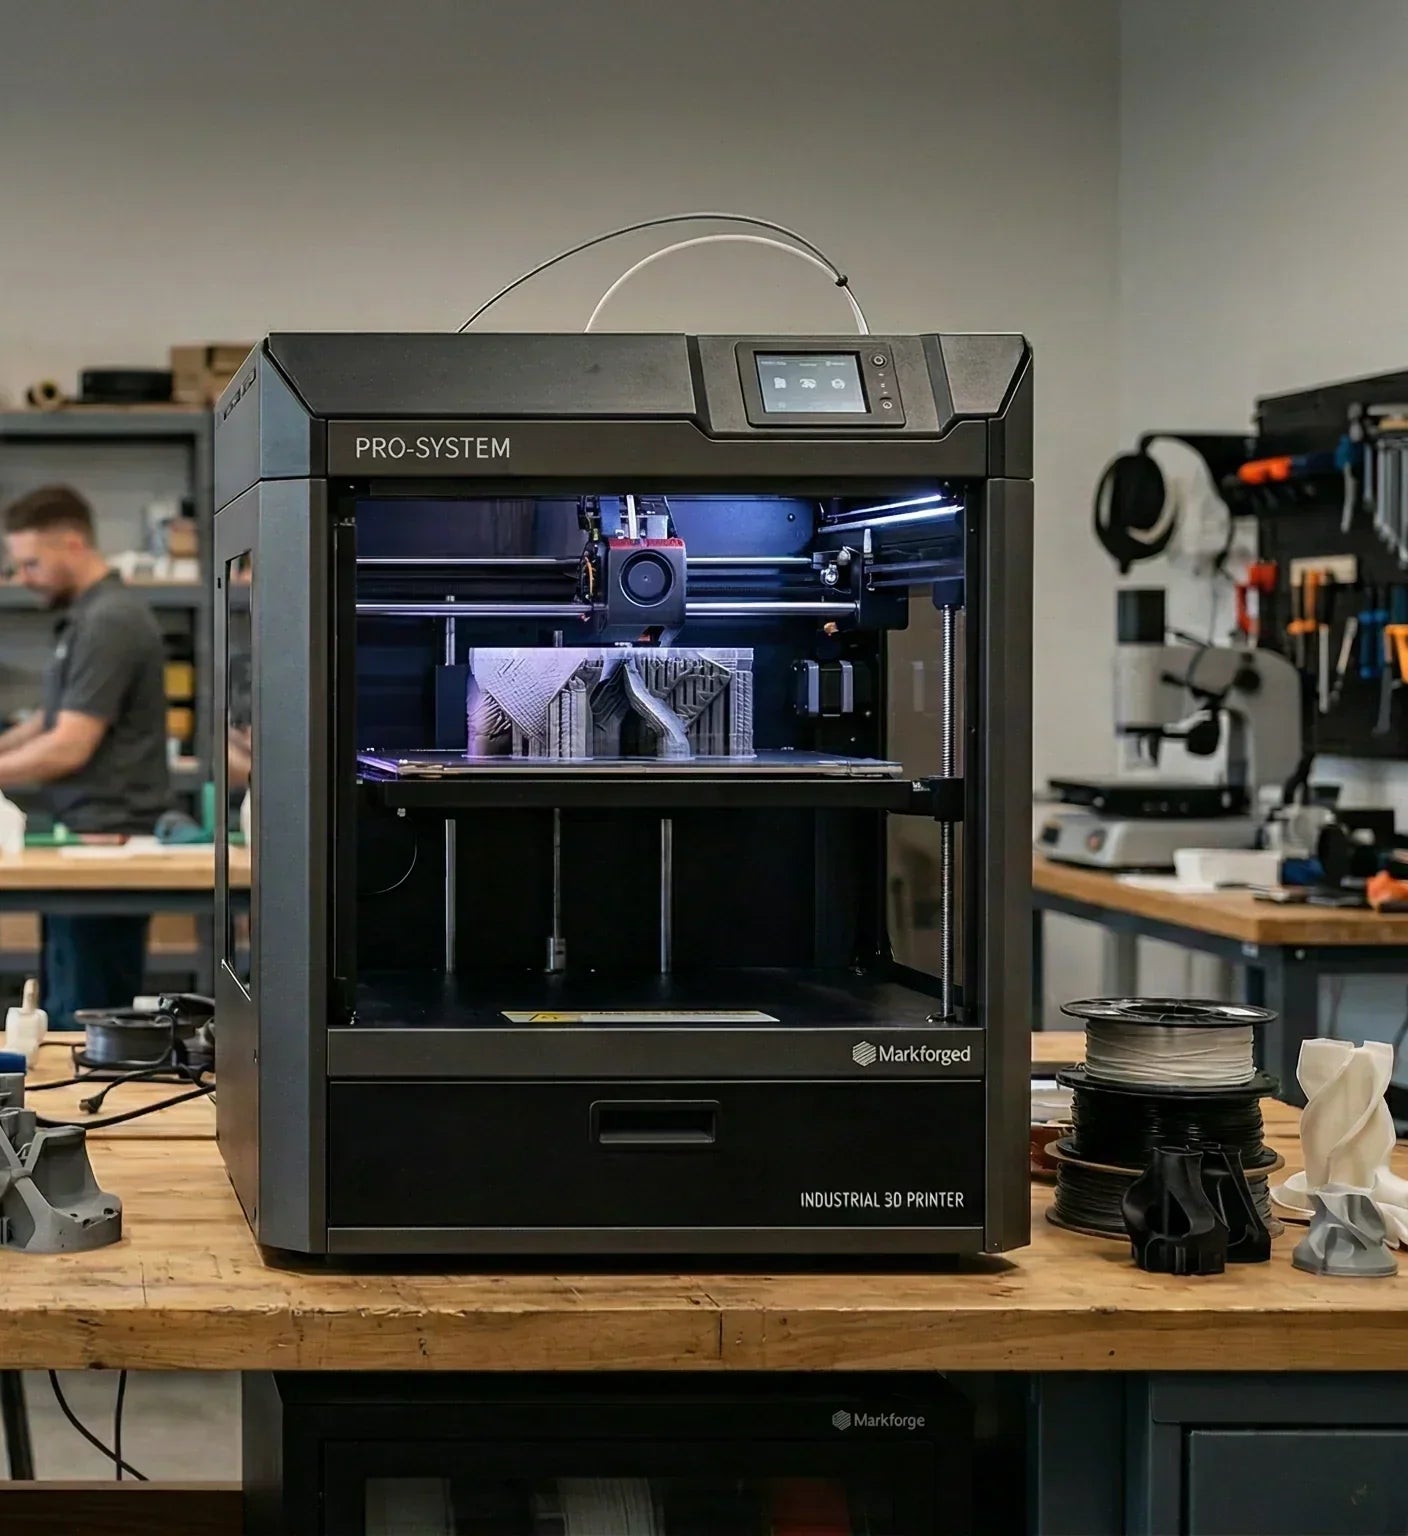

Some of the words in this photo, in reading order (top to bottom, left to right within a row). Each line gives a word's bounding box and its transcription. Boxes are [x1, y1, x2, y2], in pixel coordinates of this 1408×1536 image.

[355, 436, 510, 459] PRO-SYSTEM
[879, 1045, 971, 1066] Markforged
[800, 1192, 881, 1208] INDUSTRIAL
[884, 1192, 902, 1208] 3D
[907, 1192, 964, 1208] PRINTER
[854, 1412, 926, 1430] Markforge
